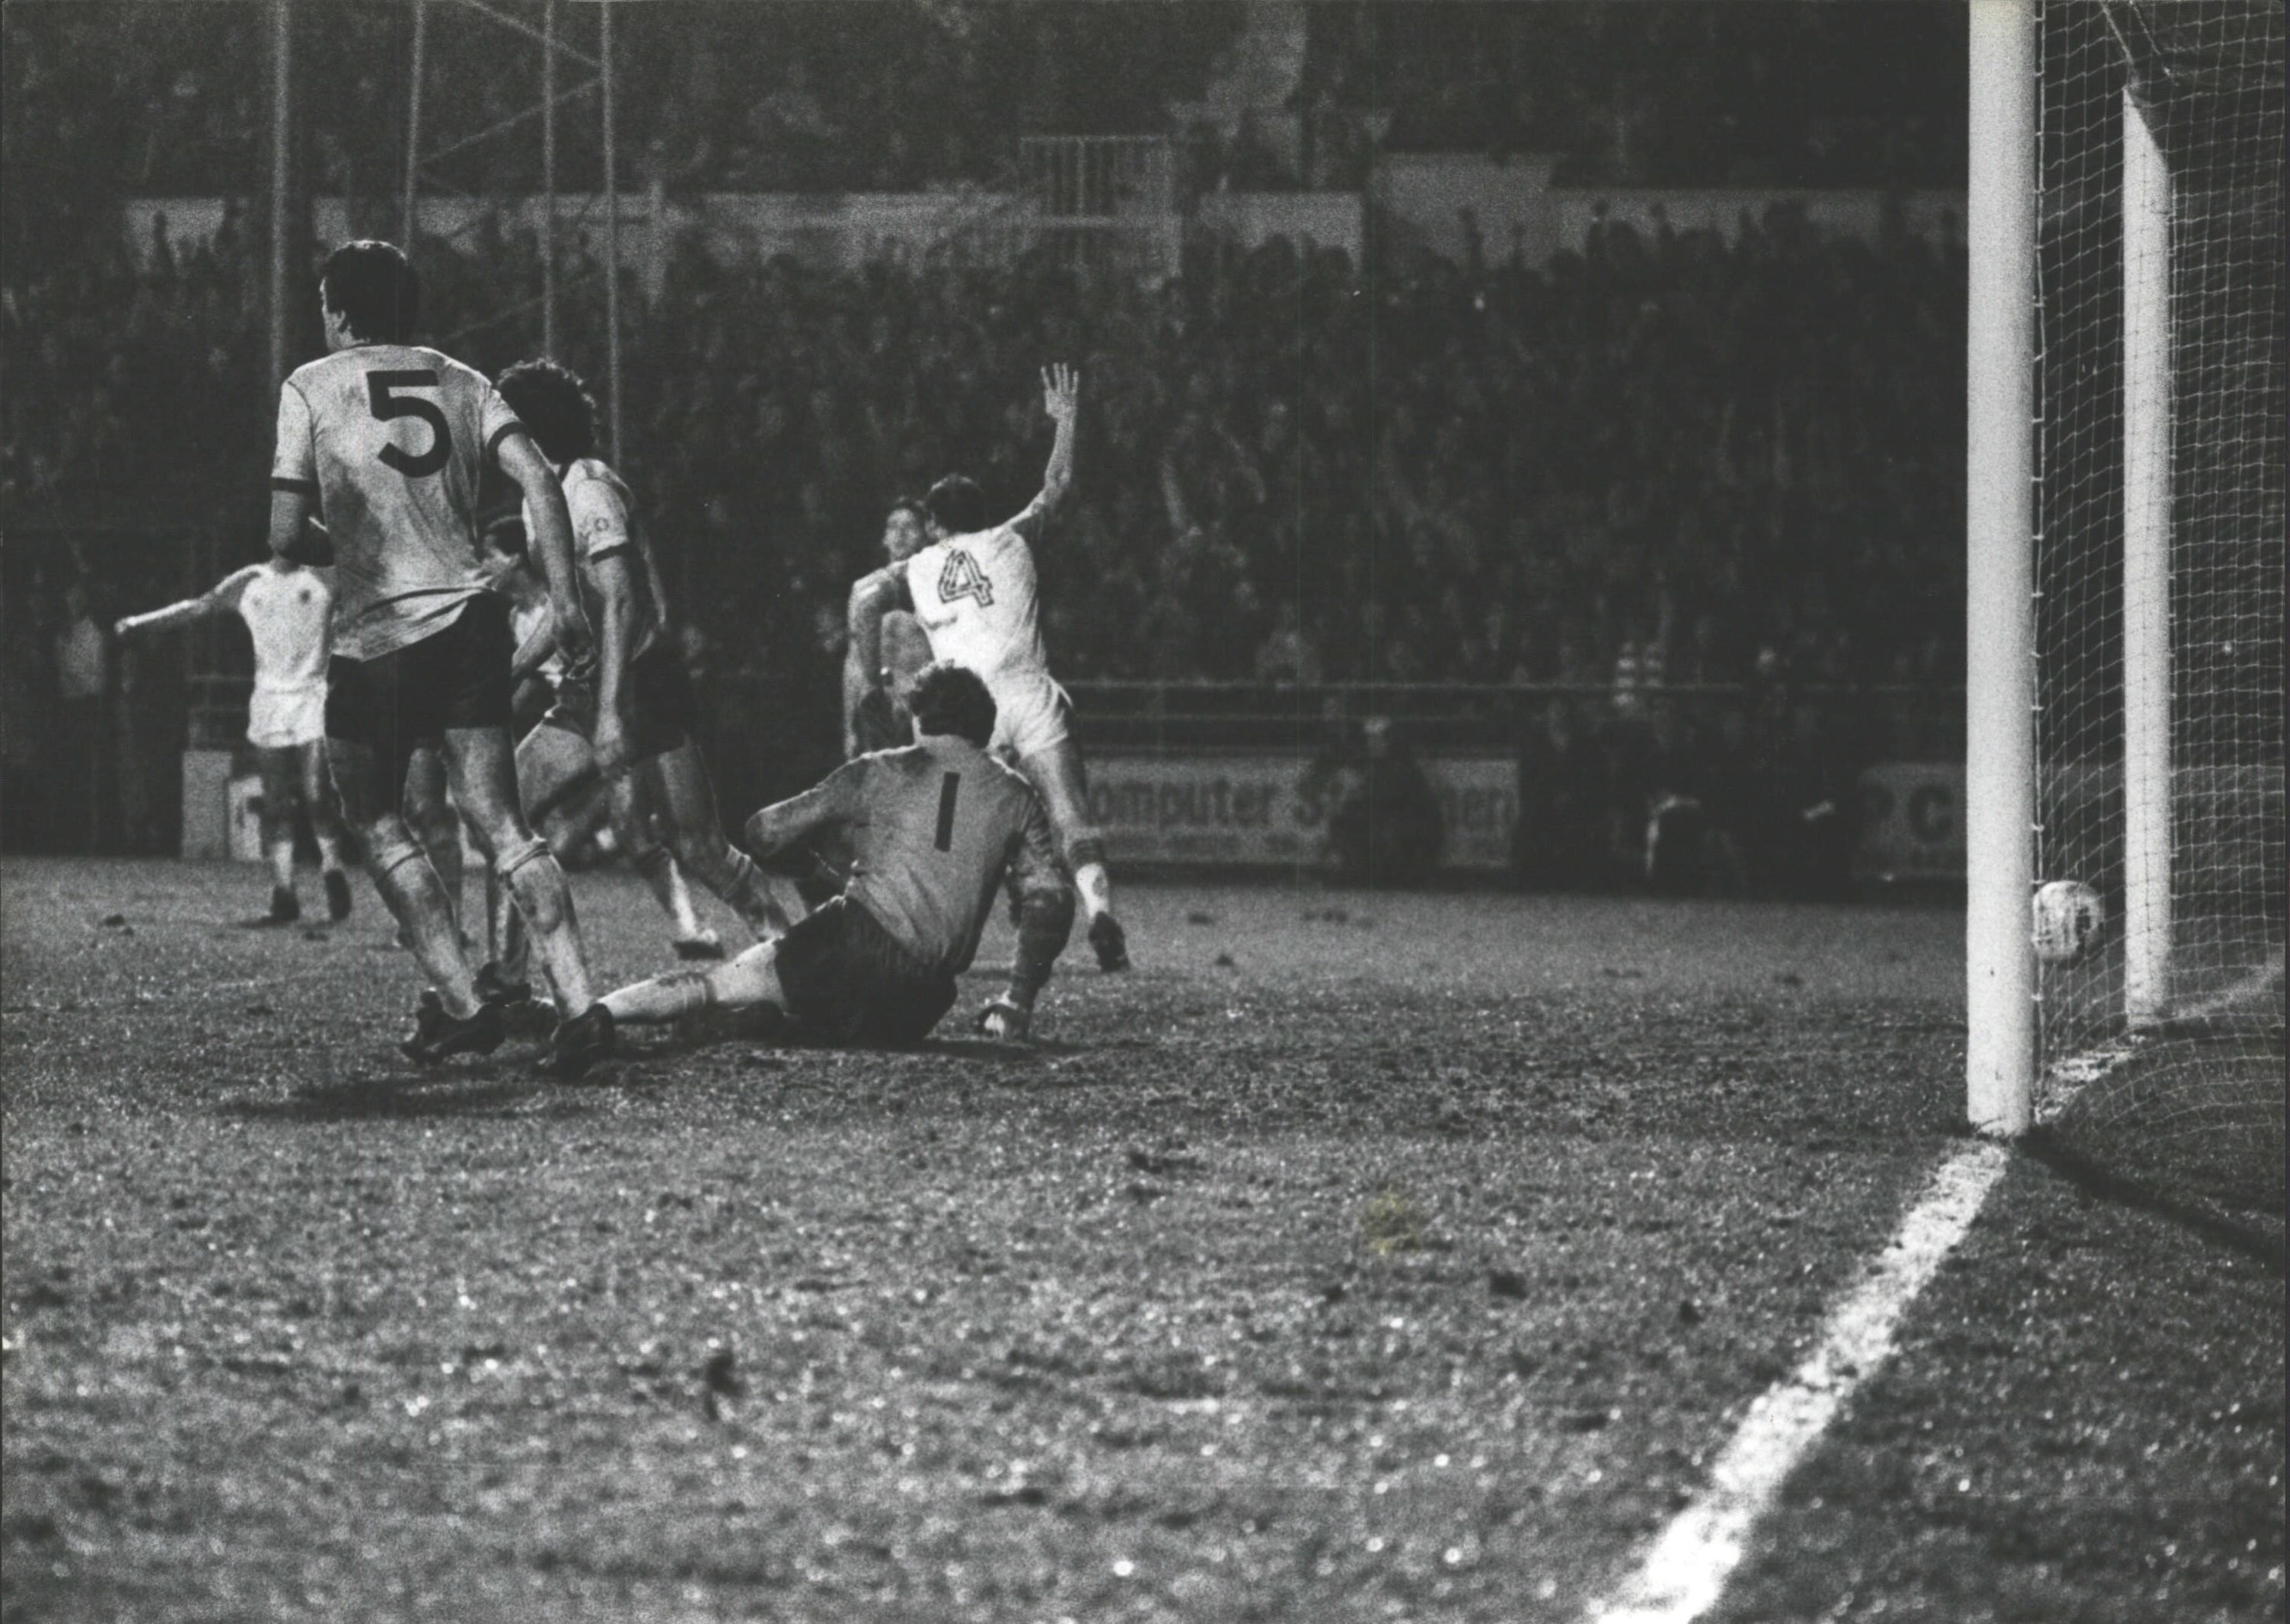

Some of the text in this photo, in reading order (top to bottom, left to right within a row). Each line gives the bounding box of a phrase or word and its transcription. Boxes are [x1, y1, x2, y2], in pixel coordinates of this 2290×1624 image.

[366, 369, 452, 478] 5
[937, 550, 994, 608] 4
[934, 771, 962, 853] 1
[1086, 777, 1279, 830] omputer
